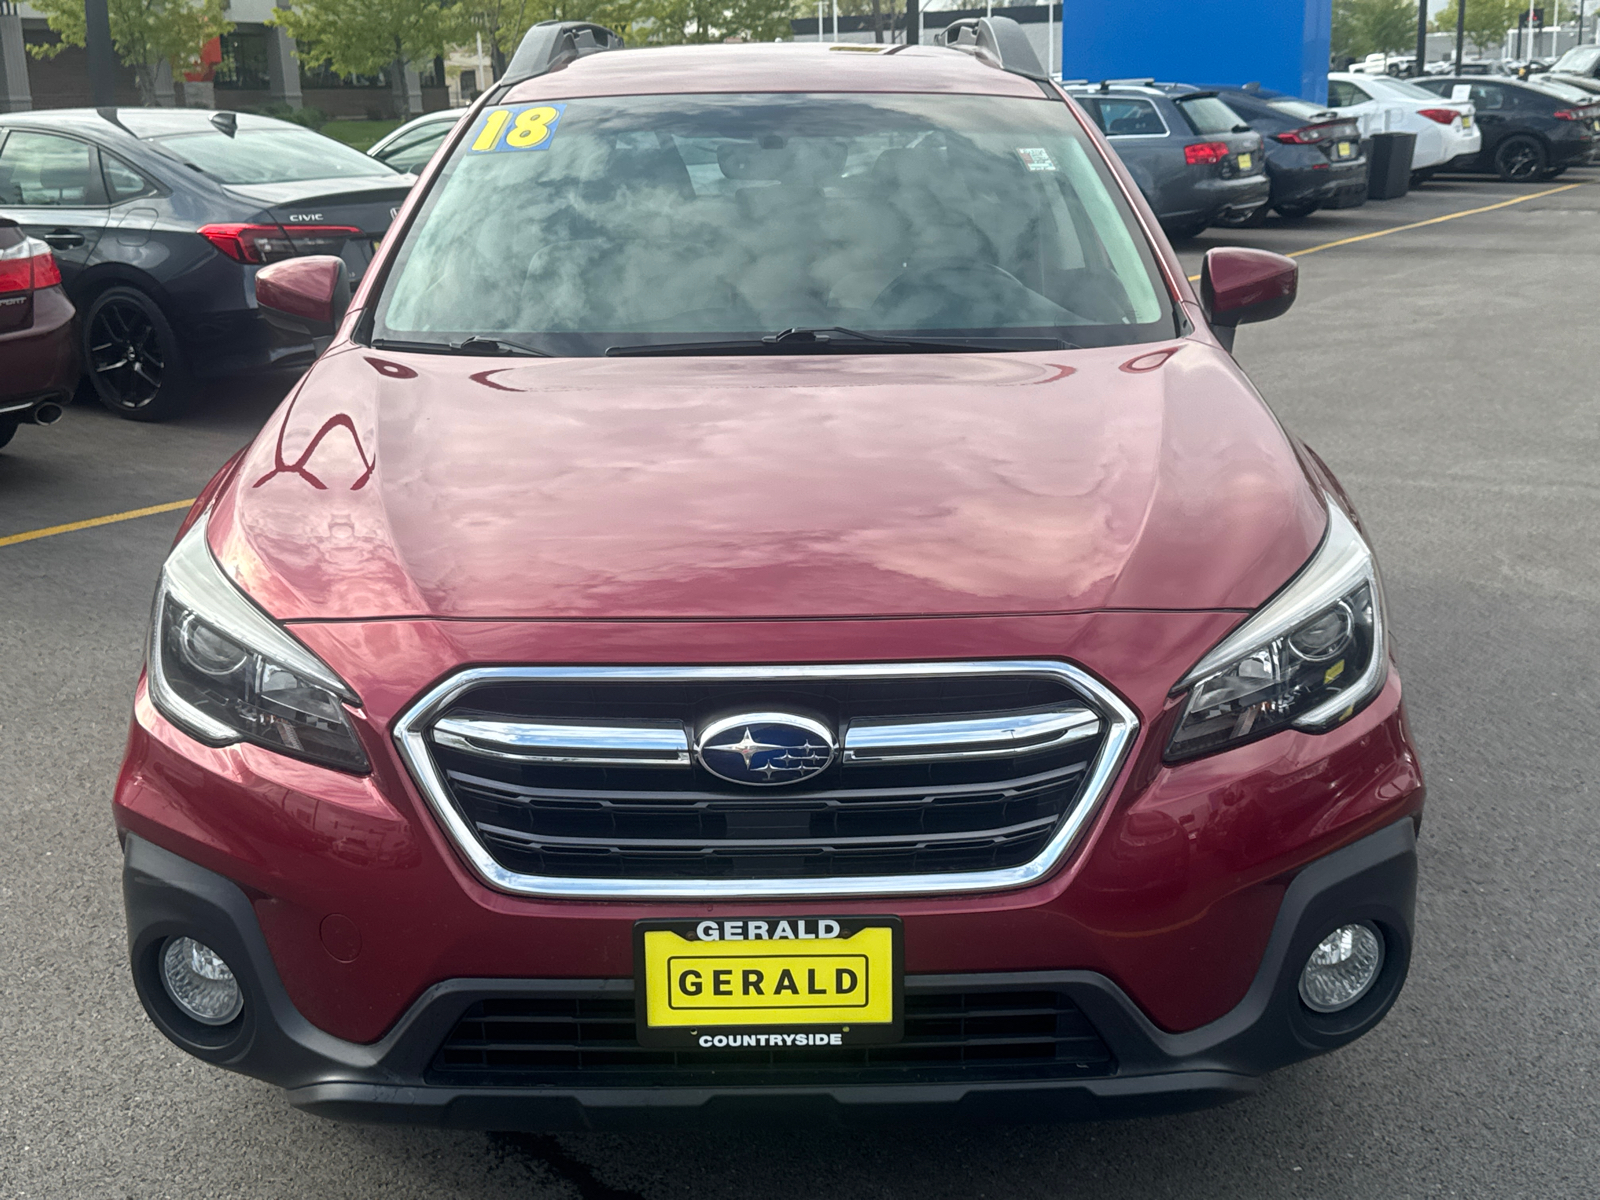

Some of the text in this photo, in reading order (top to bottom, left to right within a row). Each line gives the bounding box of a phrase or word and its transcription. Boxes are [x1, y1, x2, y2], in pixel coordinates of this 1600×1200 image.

[471, 106, 560, 152] 18
[289, 213, 324, 222] CIVIC
[696, 919, 841, 942] GERALD
[678, 968, 858, 996] GERALD
[698, 1033, 843, 1048] COUNTRYSIDE
